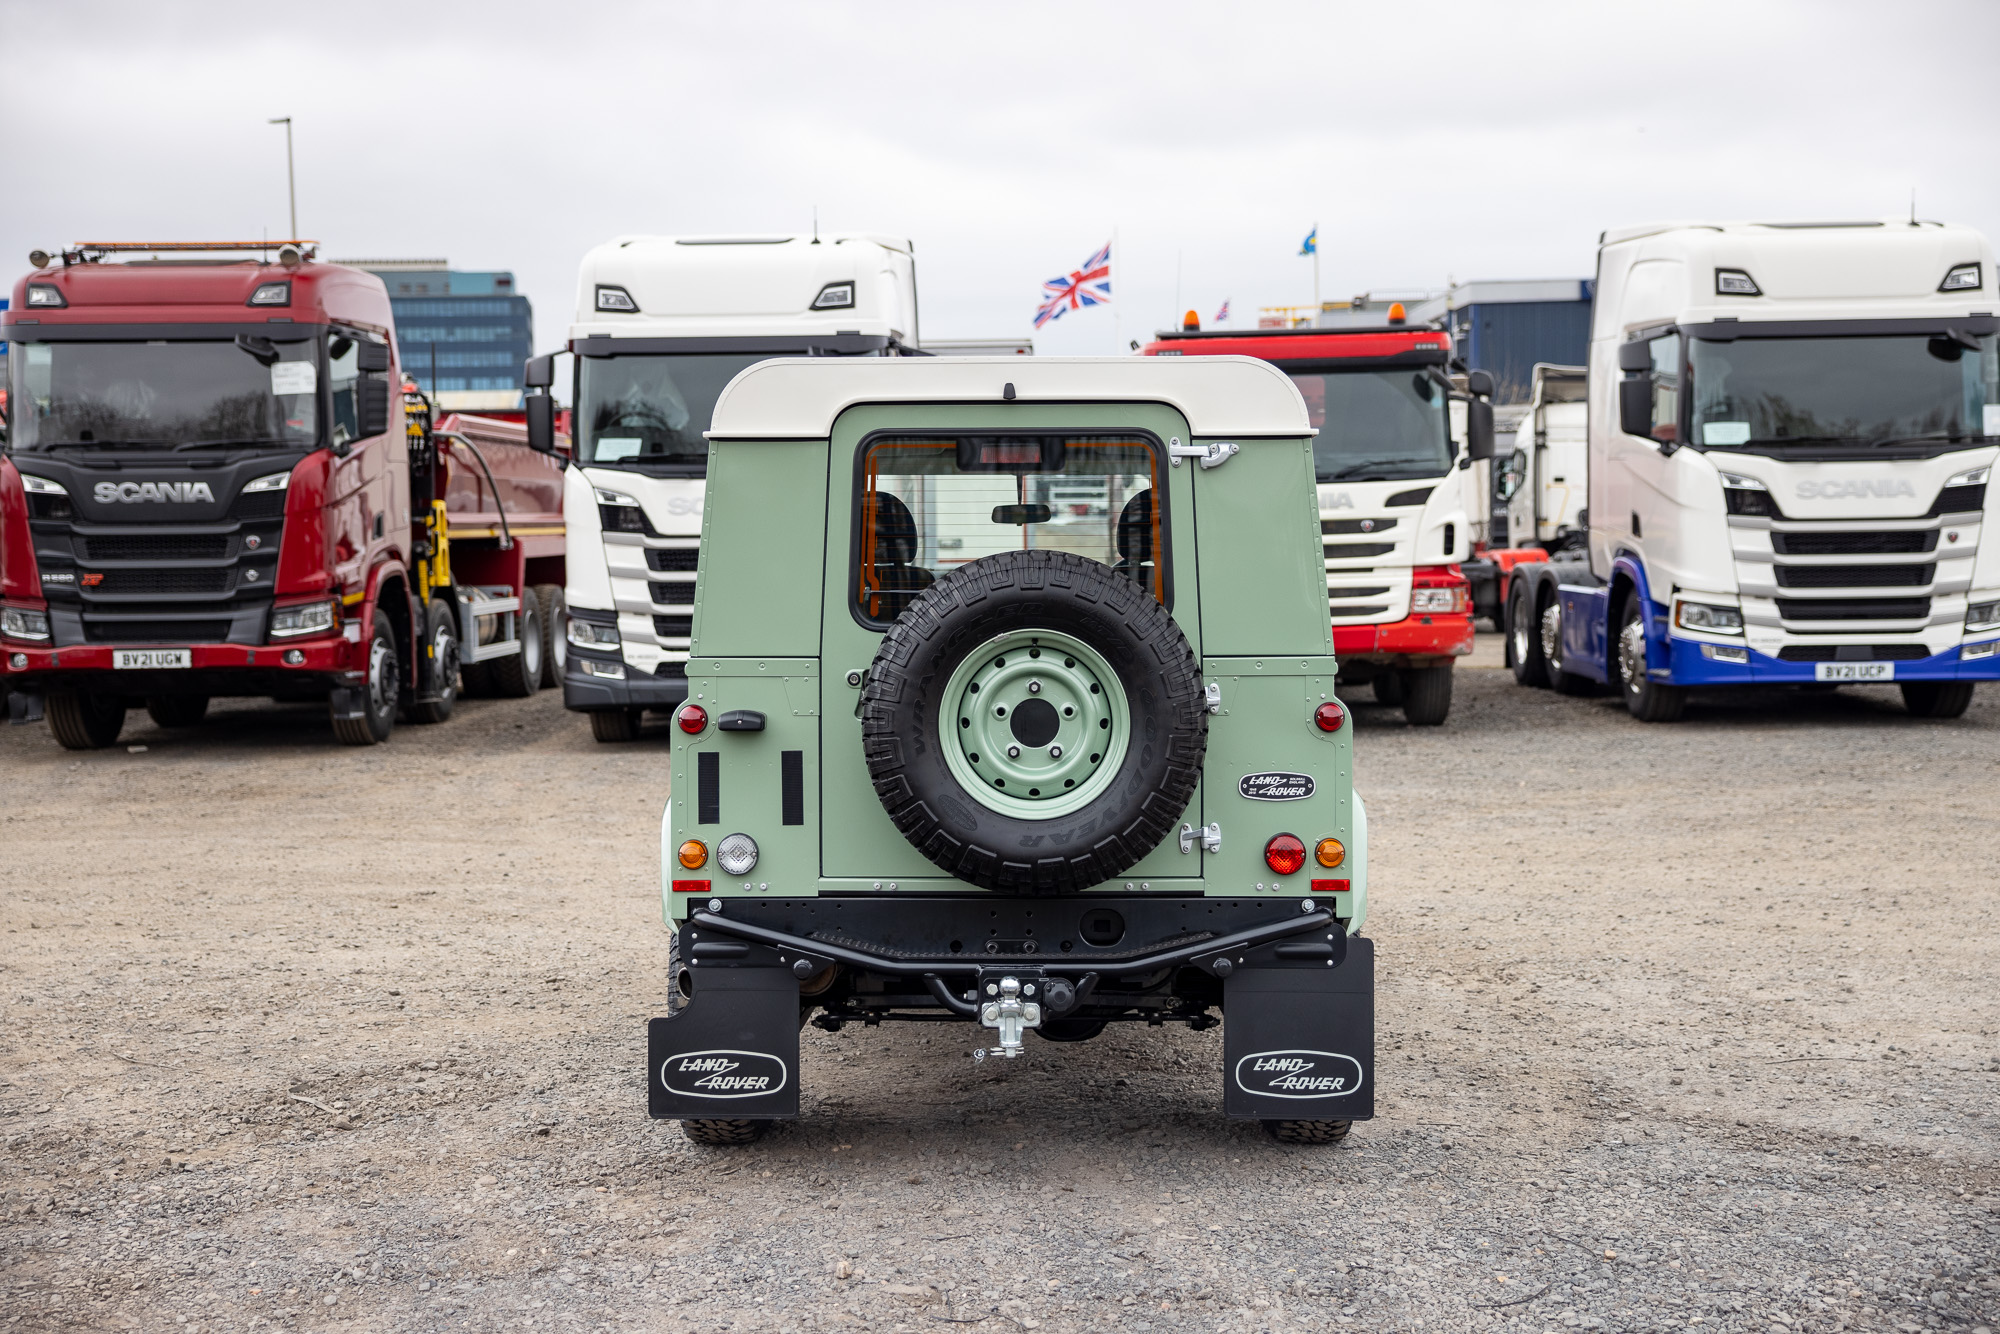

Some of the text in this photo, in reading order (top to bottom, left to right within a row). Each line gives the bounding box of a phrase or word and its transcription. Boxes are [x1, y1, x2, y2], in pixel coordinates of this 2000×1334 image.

[93, 481, 216, 504] SCANIA
[1796, 479, 1917, 500] SCANIA
[122, 652, 183, 666] BV21 UGW
[1825, 665, 1886, 678] BV21 UCP
[1018, 686, 1158, 849] GOODYEAR
[1248, 776, 1281, 785] LAND
[1266, 787, 1306, 796] ROVER
[678, 1058, 729, 1072] LAND
[1253, 1058, 1304, 1071] LAND
[707, 1076, 770, 1090] ROVER
[1282, 1076, 1345, 1090] ROVER
